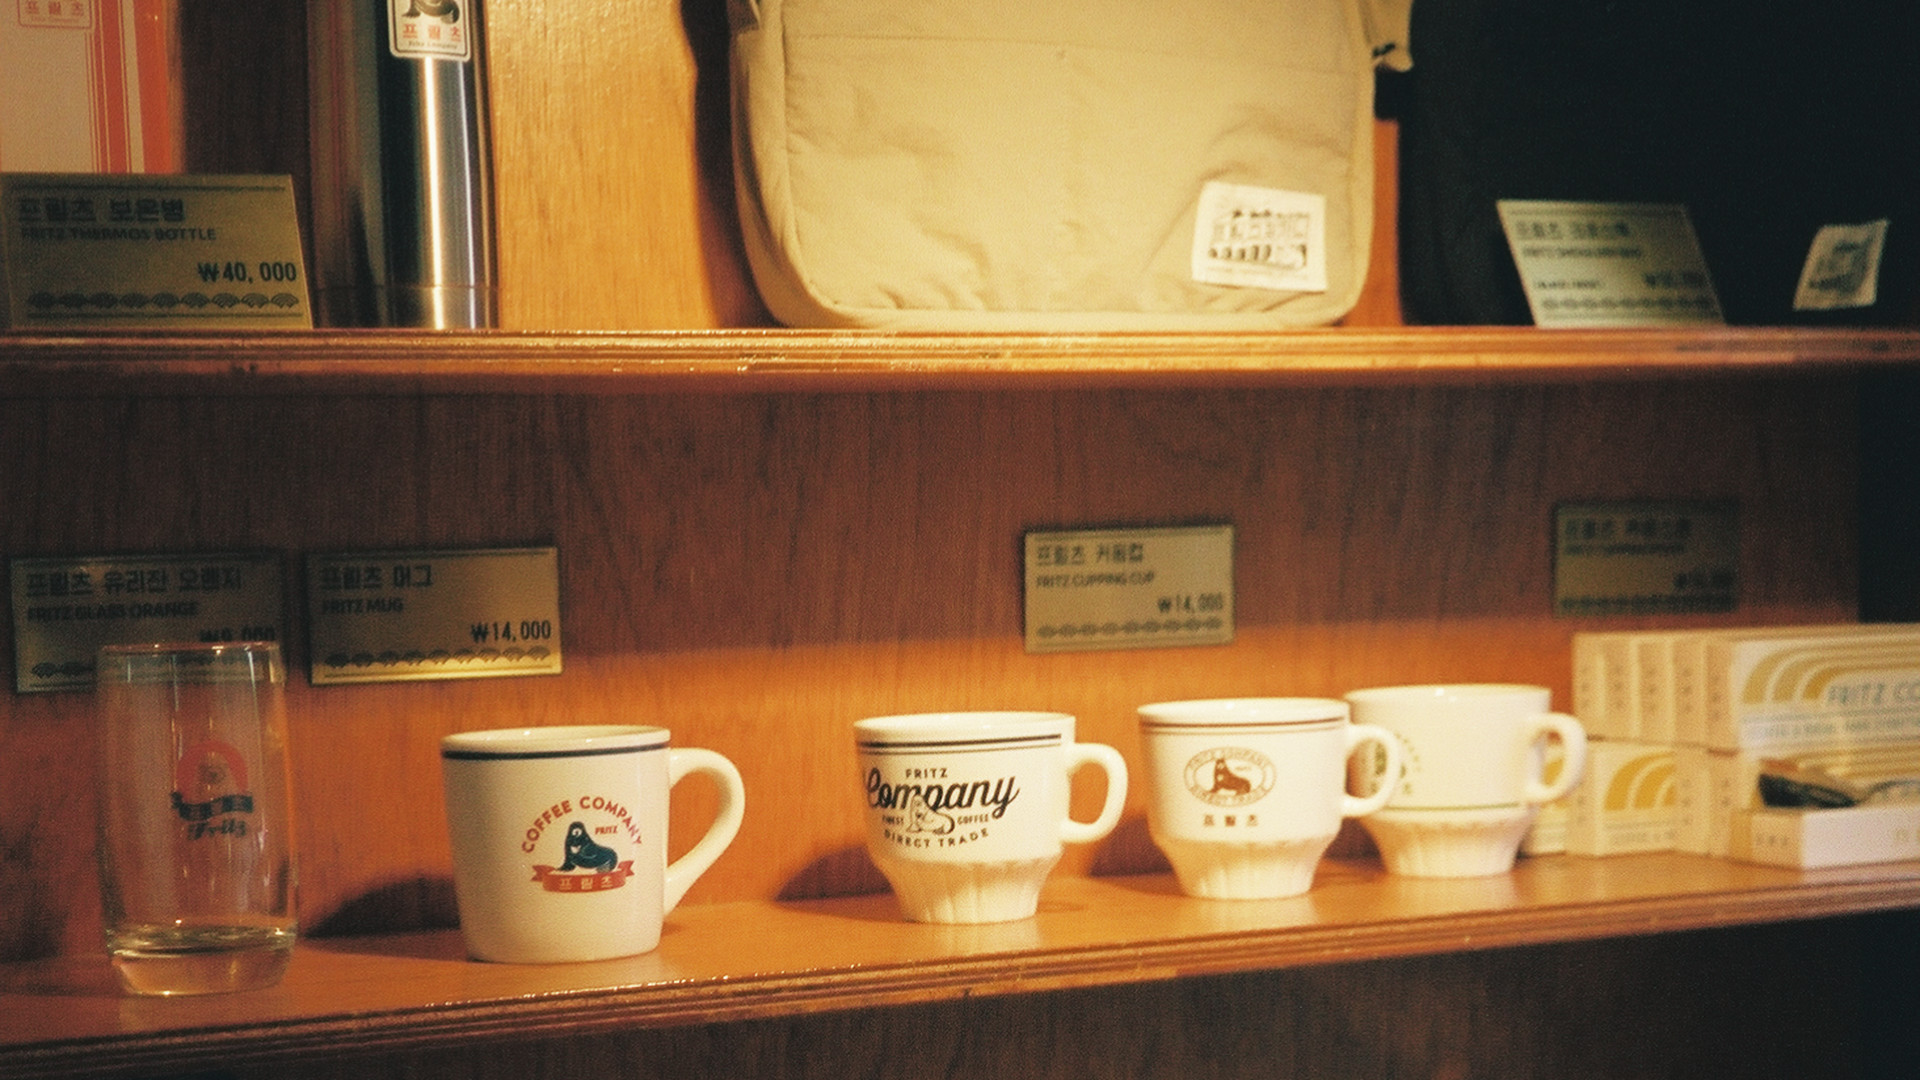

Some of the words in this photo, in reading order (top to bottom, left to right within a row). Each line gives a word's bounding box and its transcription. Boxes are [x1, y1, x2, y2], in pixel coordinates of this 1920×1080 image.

[155, 228, 217, 241] BOTTLE
[104, 568, 168, 595] 유리잔
[179, 567, 243, 592] 오렌지
[393, 564, 433, 587] 머그
[130, 601, 199, 618] ORANGE
[366, 597, 404, 612] MUG
[905, 768, 948, 779] FRITZ
[867, 767, 1021, 819] Company
[522, 800, 572, 853] COFFEE
[579, 796, 642, 845] COMPANY
[885, 828, 930, 849] DIRECT
[937, 827, 989, 848] TRADE
